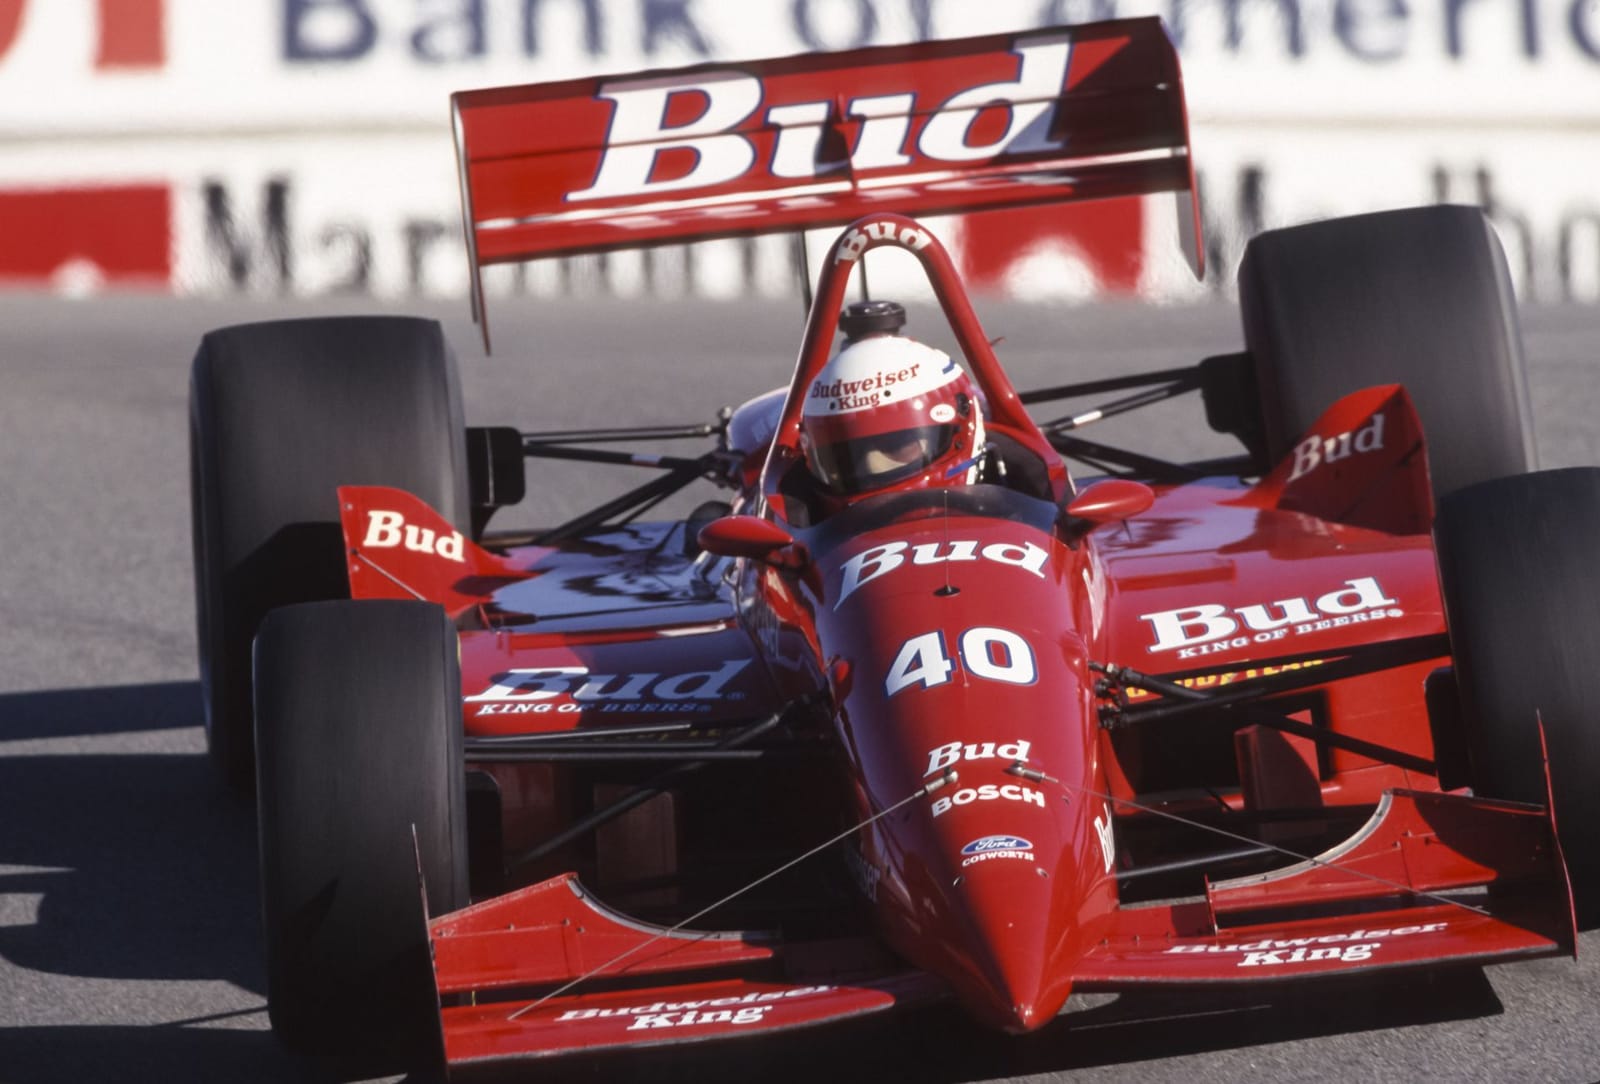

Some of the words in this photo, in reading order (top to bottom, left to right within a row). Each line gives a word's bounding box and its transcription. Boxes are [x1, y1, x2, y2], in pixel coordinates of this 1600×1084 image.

[563, 34, 1073, 203] Bud
[834, 221, 931, 265] Bud
[811, 363, 921, 399] Budweiser
[837, 391, 881, 411] King
[1286, 413, 1386, 483] Bud
[362, 510, 466, 563] Bud
[833, 539, 1049, 612] Bud
[1140, 576, 1397, 653] Bud
[1177, 637, 1248, 660] KING
[1253, 627, 1290, 644] OF
[463, 658, 752, 702] Bud
[884, 626, 1039, 698] 40
[475, 703, 556, 718] KING
[557, 702, 595, 714] OF
[923, 739, 1032, 778] Bud
[931, 784, 1046, 818] BOSCH
[962, 850, 1035, 868] COSWORTH
[974, 837, 1018, 851] Ford
[1163, 922, 1449, 954] Budweiser
[1236, 943, 1382, 968] King
[553, 985, 839, 1022] Budweiser
[626, 1005, 773, 1031] King
